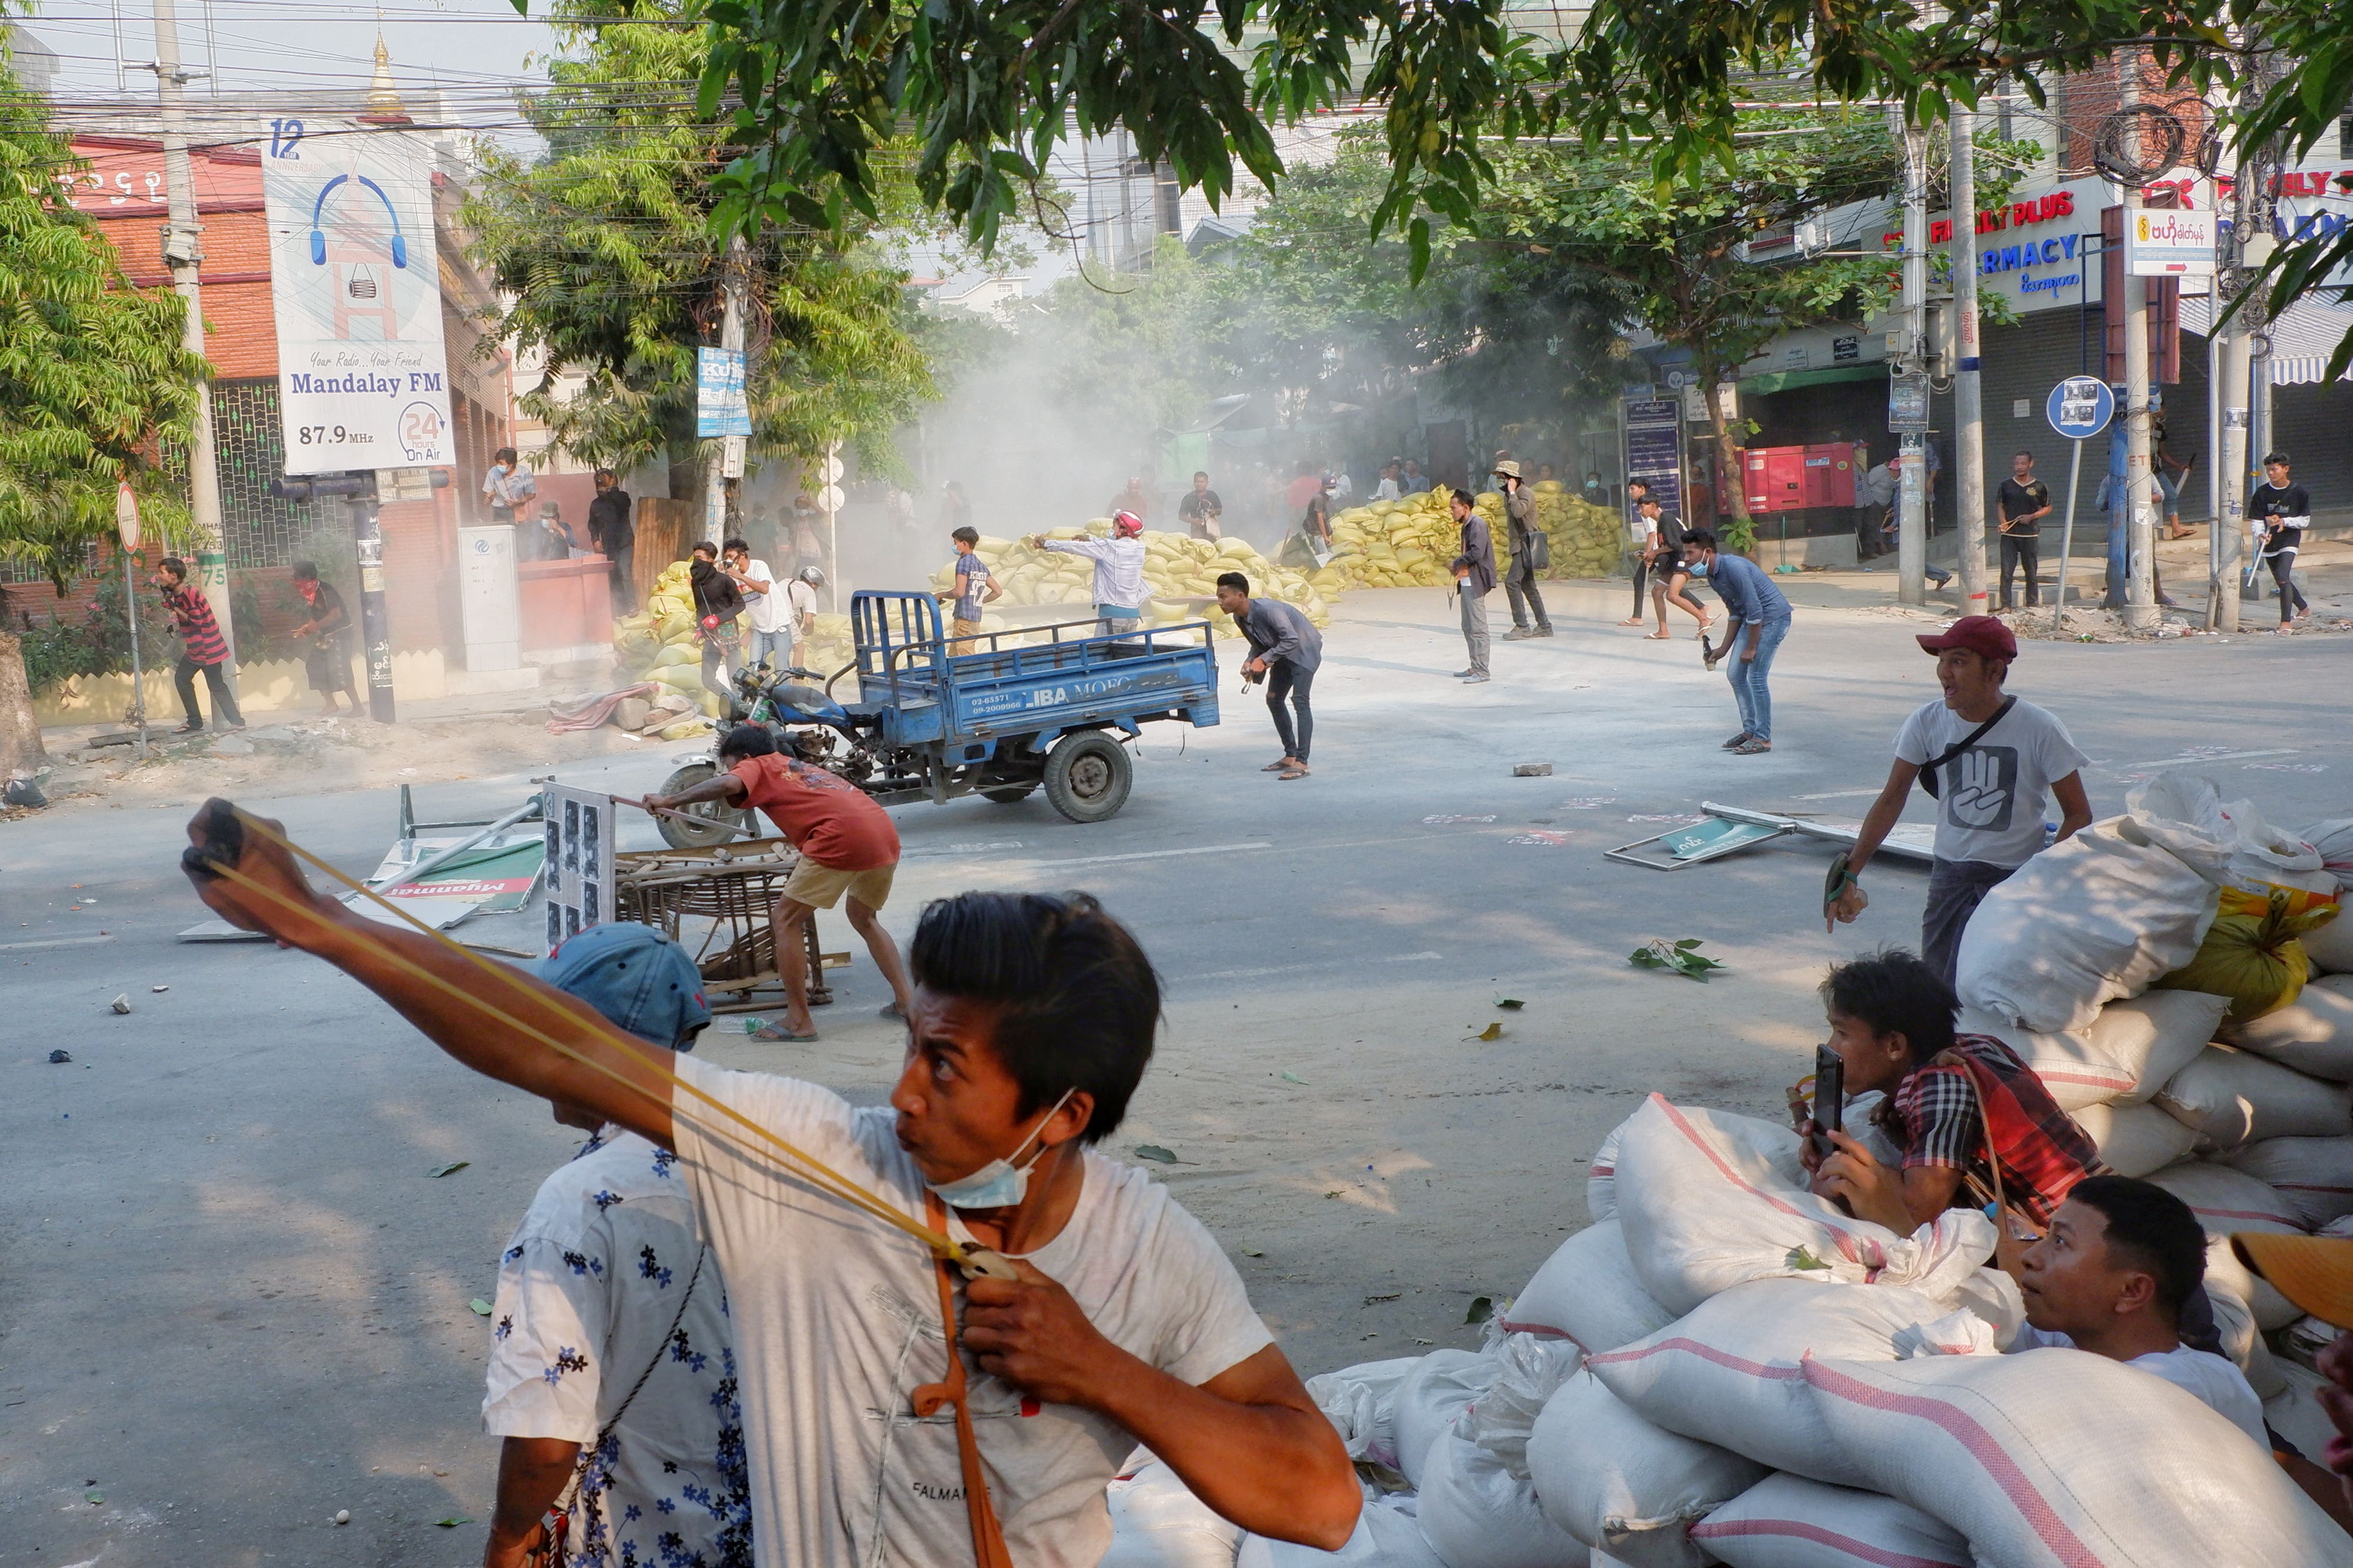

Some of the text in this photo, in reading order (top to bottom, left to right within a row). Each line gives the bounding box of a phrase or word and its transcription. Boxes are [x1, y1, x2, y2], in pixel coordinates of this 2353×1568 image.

[271, 119, 304, 159] 12
[2014, 191, 2074, 226] PLUS
[310, 352, 331, 368] Your
[370, 351, 390, 368] Your
[394, 352, 423, 367] Friend
[291, 372, 442, 398] Mandalay FM
[299, 425, 374, 445] 87.9 MHz
[406, 412, 439, 441] 24
[412, 441, 435, 449] hours
[407, 448, 441, 461] On Air
[379, 471, 394, 485] FOR
[202, 569, 225, 587] 75
[972, 694, 1009, 706] 02-65571
[385, 882, 505, 896] Myanmar
